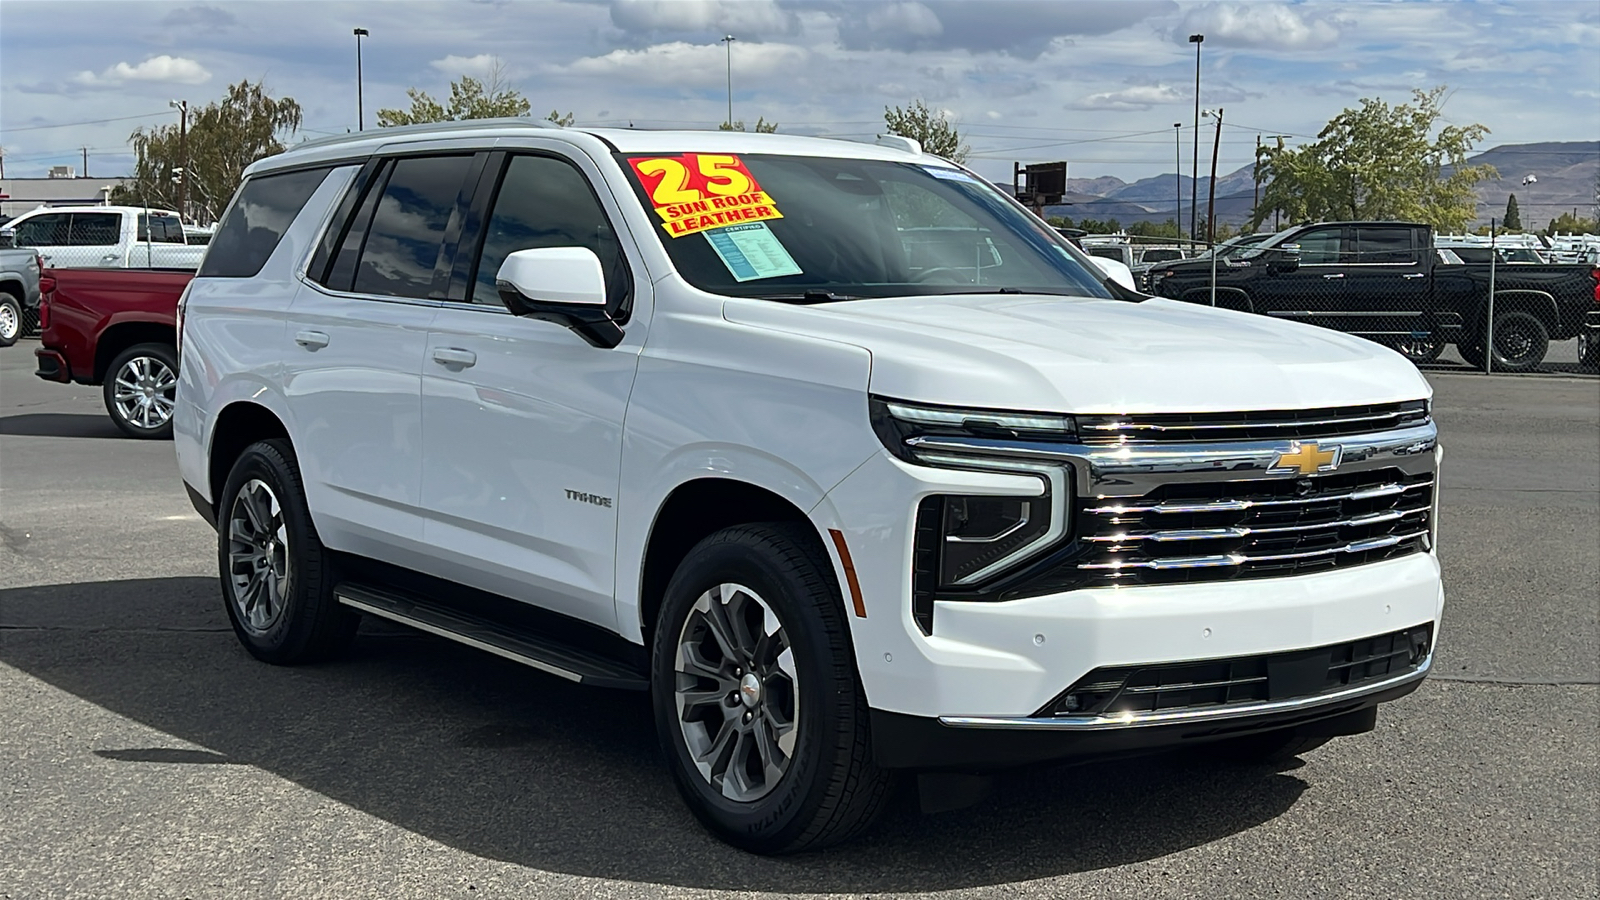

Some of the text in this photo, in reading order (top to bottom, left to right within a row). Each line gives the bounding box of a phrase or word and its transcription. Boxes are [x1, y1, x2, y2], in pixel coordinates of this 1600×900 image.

[637, 154, 754, 204] 25
[666, 193, 763, 218] SUN ROOF
[671, 207, 772, 234] LEATHER
[564, 488, 612, 508] TAHOE
